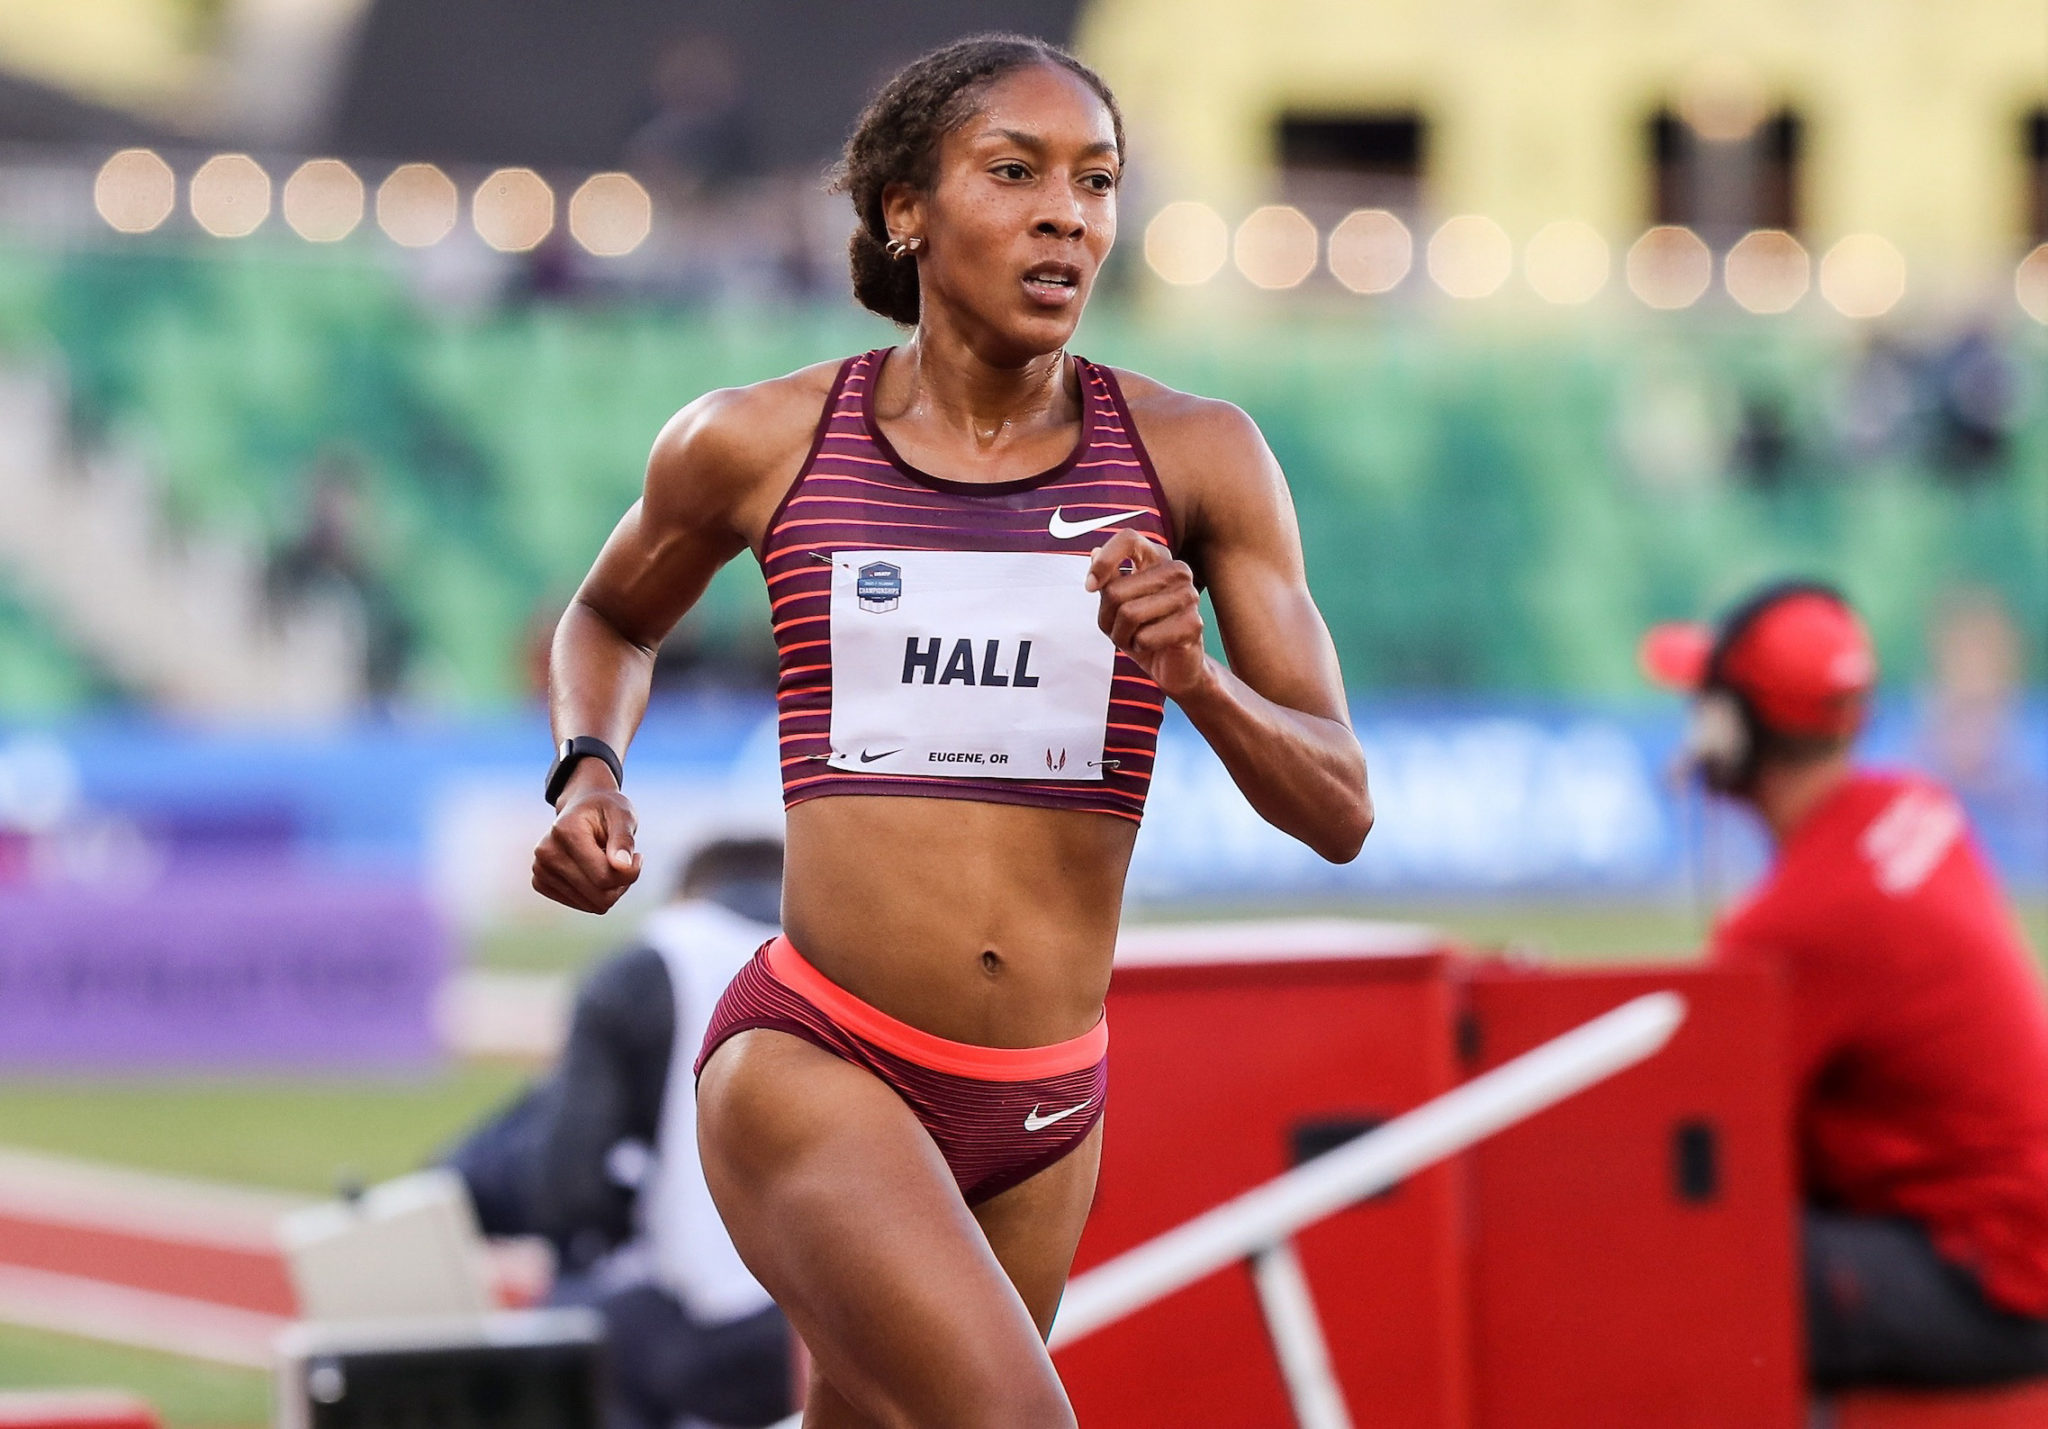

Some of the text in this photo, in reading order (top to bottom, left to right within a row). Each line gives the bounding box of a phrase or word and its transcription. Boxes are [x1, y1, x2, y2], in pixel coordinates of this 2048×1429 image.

[901, 636, 1040, 688] HALL
[928, 752, 1009, 765] EUGENE, OR
